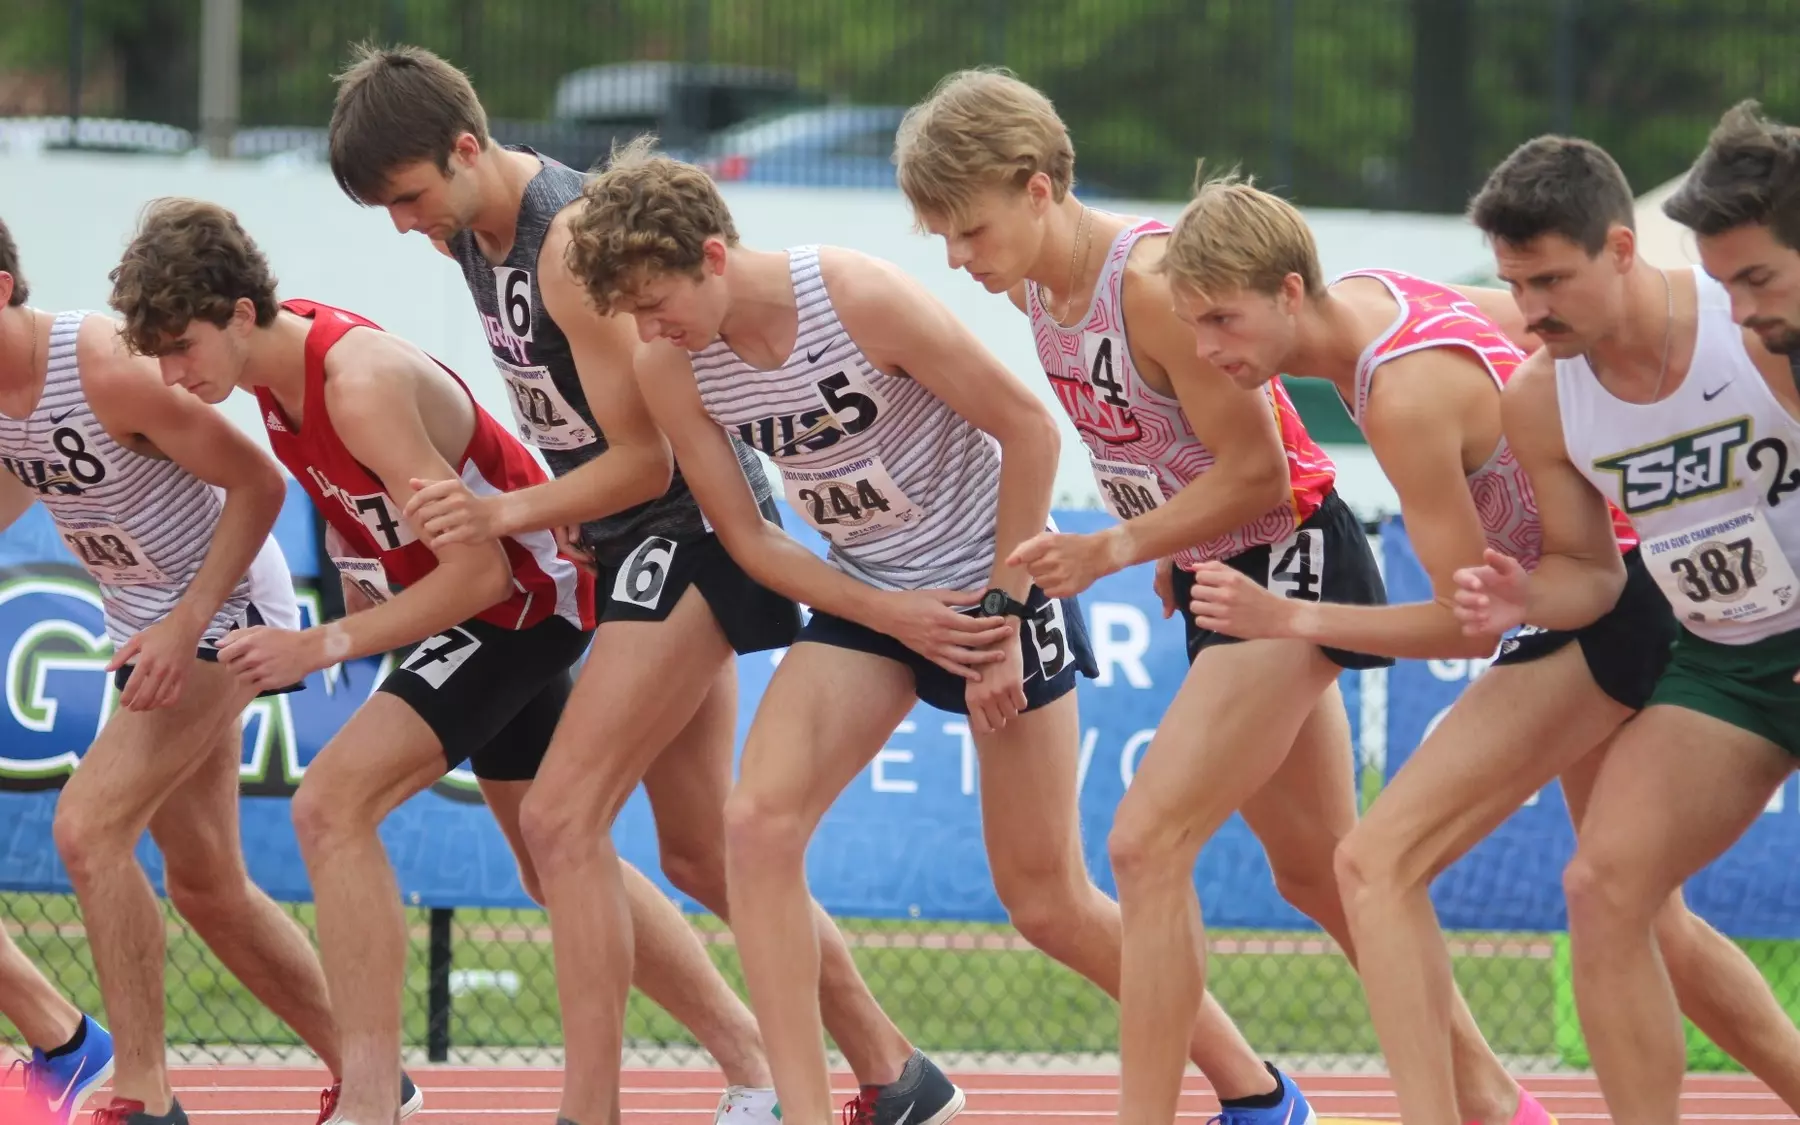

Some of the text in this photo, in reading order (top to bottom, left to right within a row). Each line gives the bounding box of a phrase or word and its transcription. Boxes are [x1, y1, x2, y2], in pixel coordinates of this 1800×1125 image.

[505, 270, 531, 337] 6
[817, 371, 878, 435] 5
[1091, 338, 1130, 409] 4
[53, 427, 105, 484] 8
[813, 457, 874, 481] CHAMPIONSHIPS
[1614, 424, 1742, 510] S&T
[1747, 437, 1800, 507] 2
[355, 496, 401, 549] 7
[799, 479, 891, 525] 244
[1650, 512, 1755, 555] 2024 GLVC CHAMPIONSHIPS
[64, 533, 139, 567] 243
[335, 561, 377, 572] AMPIONSHIPS
[626, 538, 673, 602] 6
[1272, 531, 1320, 601] 4
[1670, 536, 1757, 603] 387
[406, 627, 475, 672] 7
[1034, 602, 1065, 678] 5
